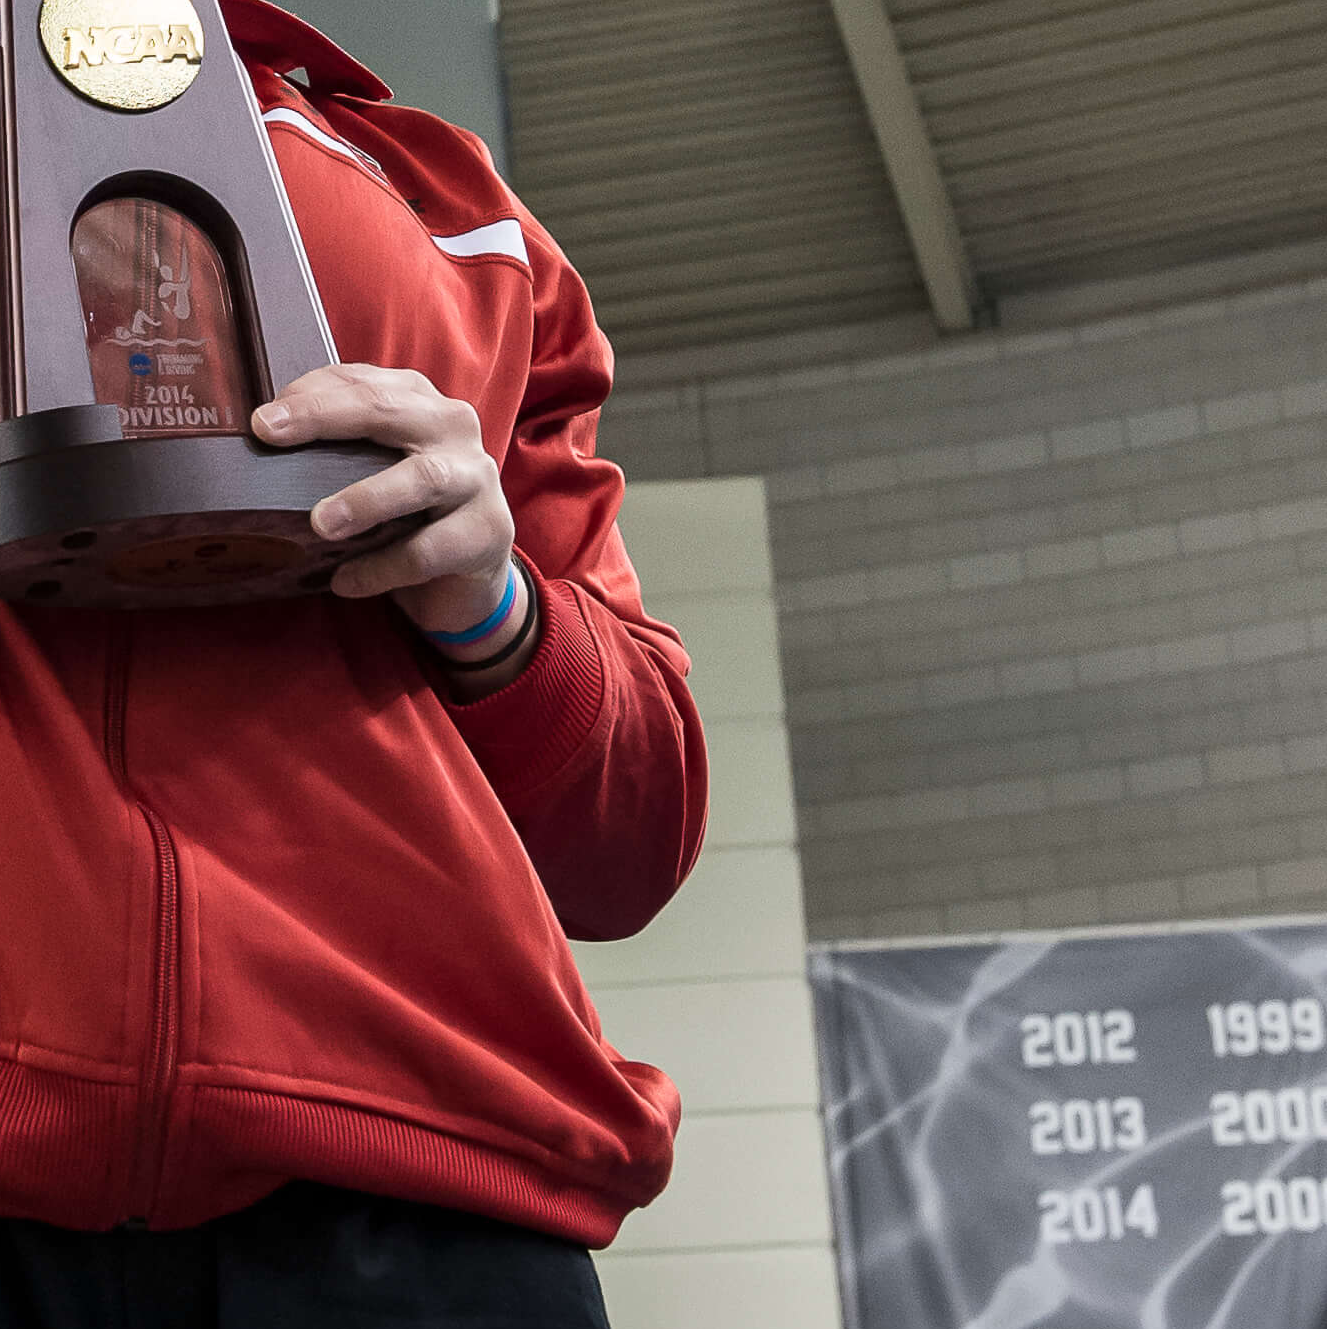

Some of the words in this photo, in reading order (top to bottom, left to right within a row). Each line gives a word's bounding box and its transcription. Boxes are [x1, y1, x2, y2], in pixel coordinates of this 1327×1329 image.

[63, 24, 202, 69] NCAA
[144, 384, 195, 405] 2014
[1021, 1009, 1137, 1068] 2012
[1207, 998, 1324, 1058] 1999
[1029, 1096, 1146, 1155] 2013
[1038, 1184, 1158, 1243] 2014
[1221, 1177, 1327, 1236] 200
